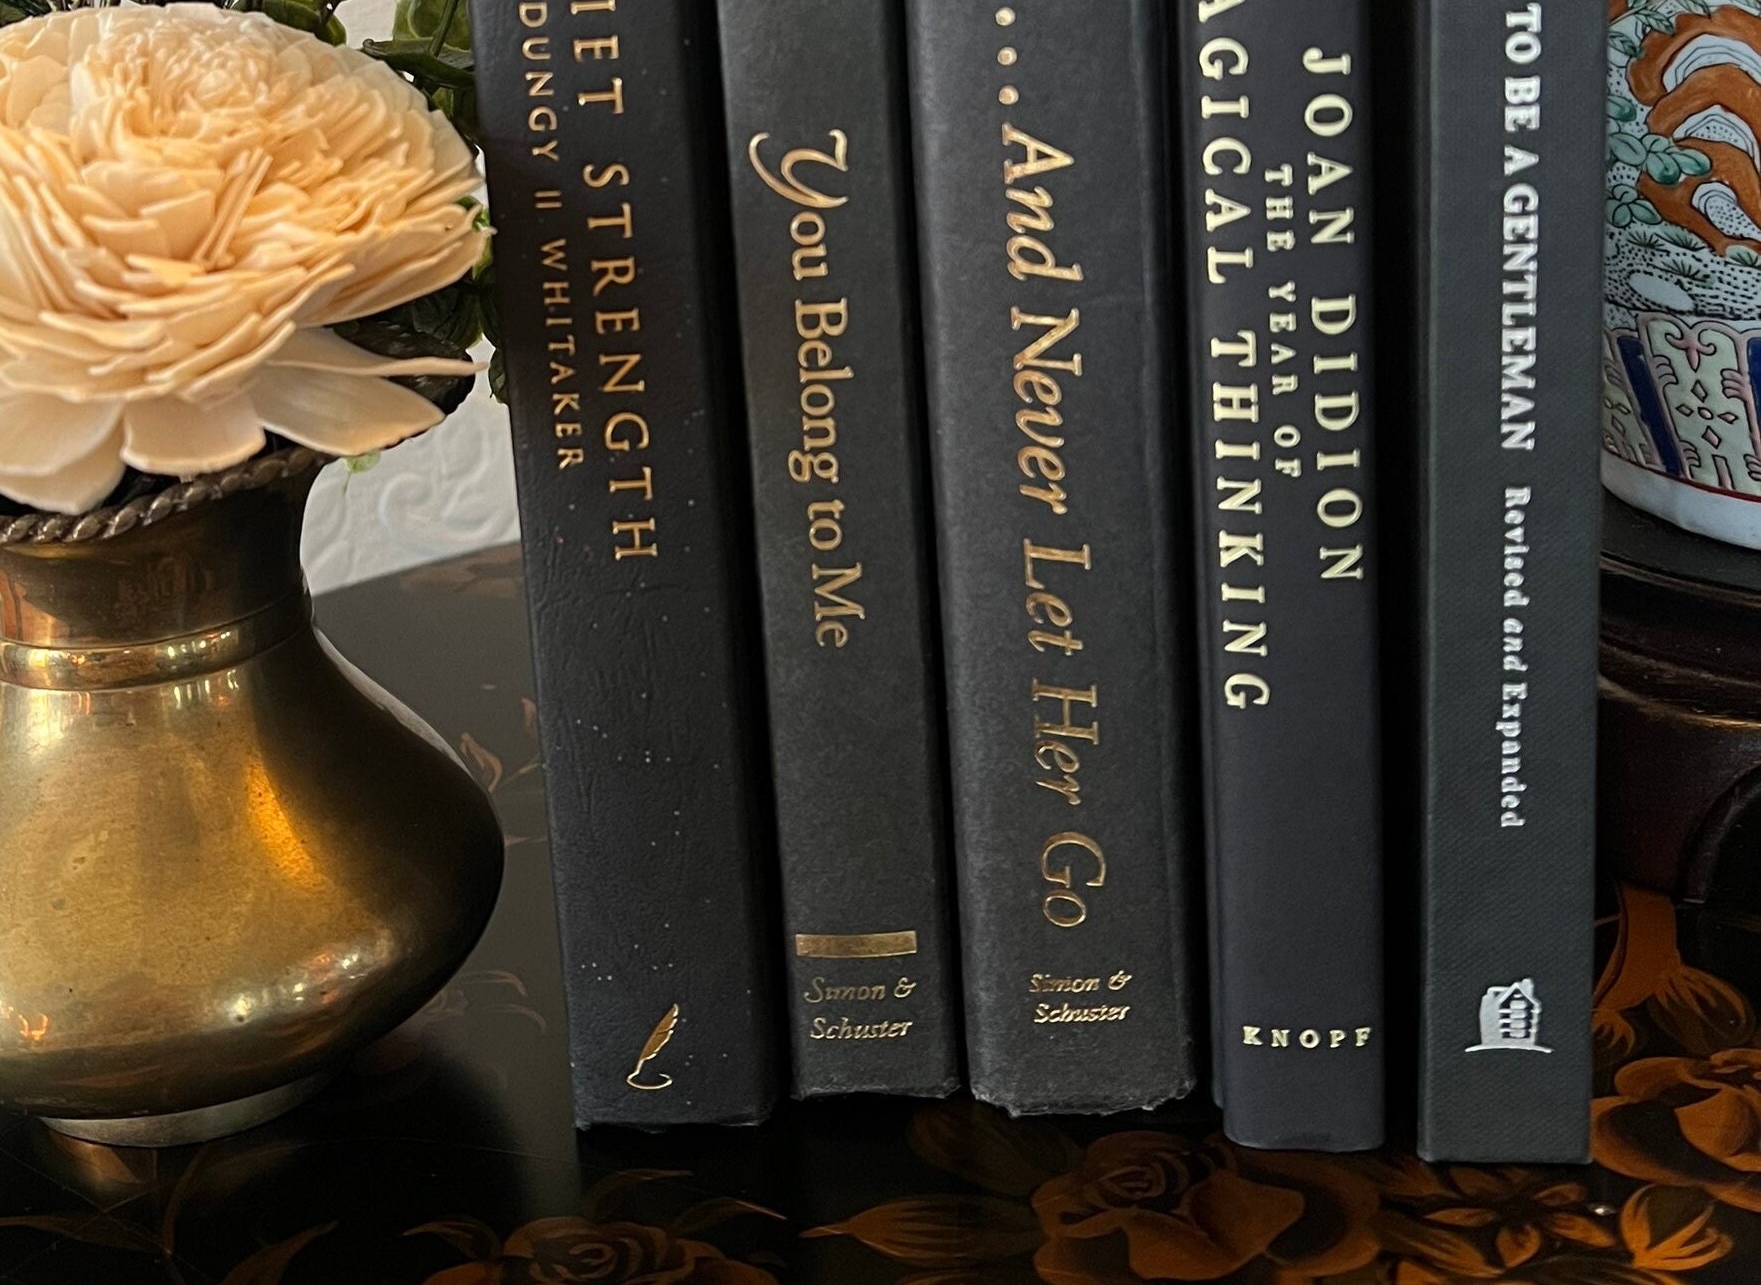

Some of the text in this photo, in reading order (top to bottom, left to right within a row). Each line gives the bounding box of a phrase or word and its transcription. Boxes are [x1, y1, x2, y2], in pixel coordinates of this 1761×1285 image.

[1505, 2, 1542, 64] TO
[1503, 146, 1539, 175] A
[1504, 76, 1541, 132] BE
[518, 2, 584, 470] DUNGY II WHITAKER
[1001, 123, 1083, 281] And
[583, 163, 658, 561] STRENGTH
[1264, 164, 1301, 478] THE YEAR OF
[1302, 47, 1363, 579] JOAN DIDION
[1501, 184, 1539, 450] GENTLEMAN
[748, 129, 866, 648] You Belong to Me
[1010, 306, 1082, 515] Never
[1210, 330, 1271, 709] THINKING
[1023, 538, 1091, 656] Let
[1495, 487, 1531, 828] Revised and Expanded
[1032, 679, 1099, 806] Her
[1042, 832, 1106, 928] Go
[803, 976, 917, 1004] Simon &
[809, 1017, 913, 1040] Schuster
[1028, 970, 1133, 993] Simon &
[1033, 1002, 1130, 1024] Schuster
[1242, 1025, 1371, 1049] KNOPF
